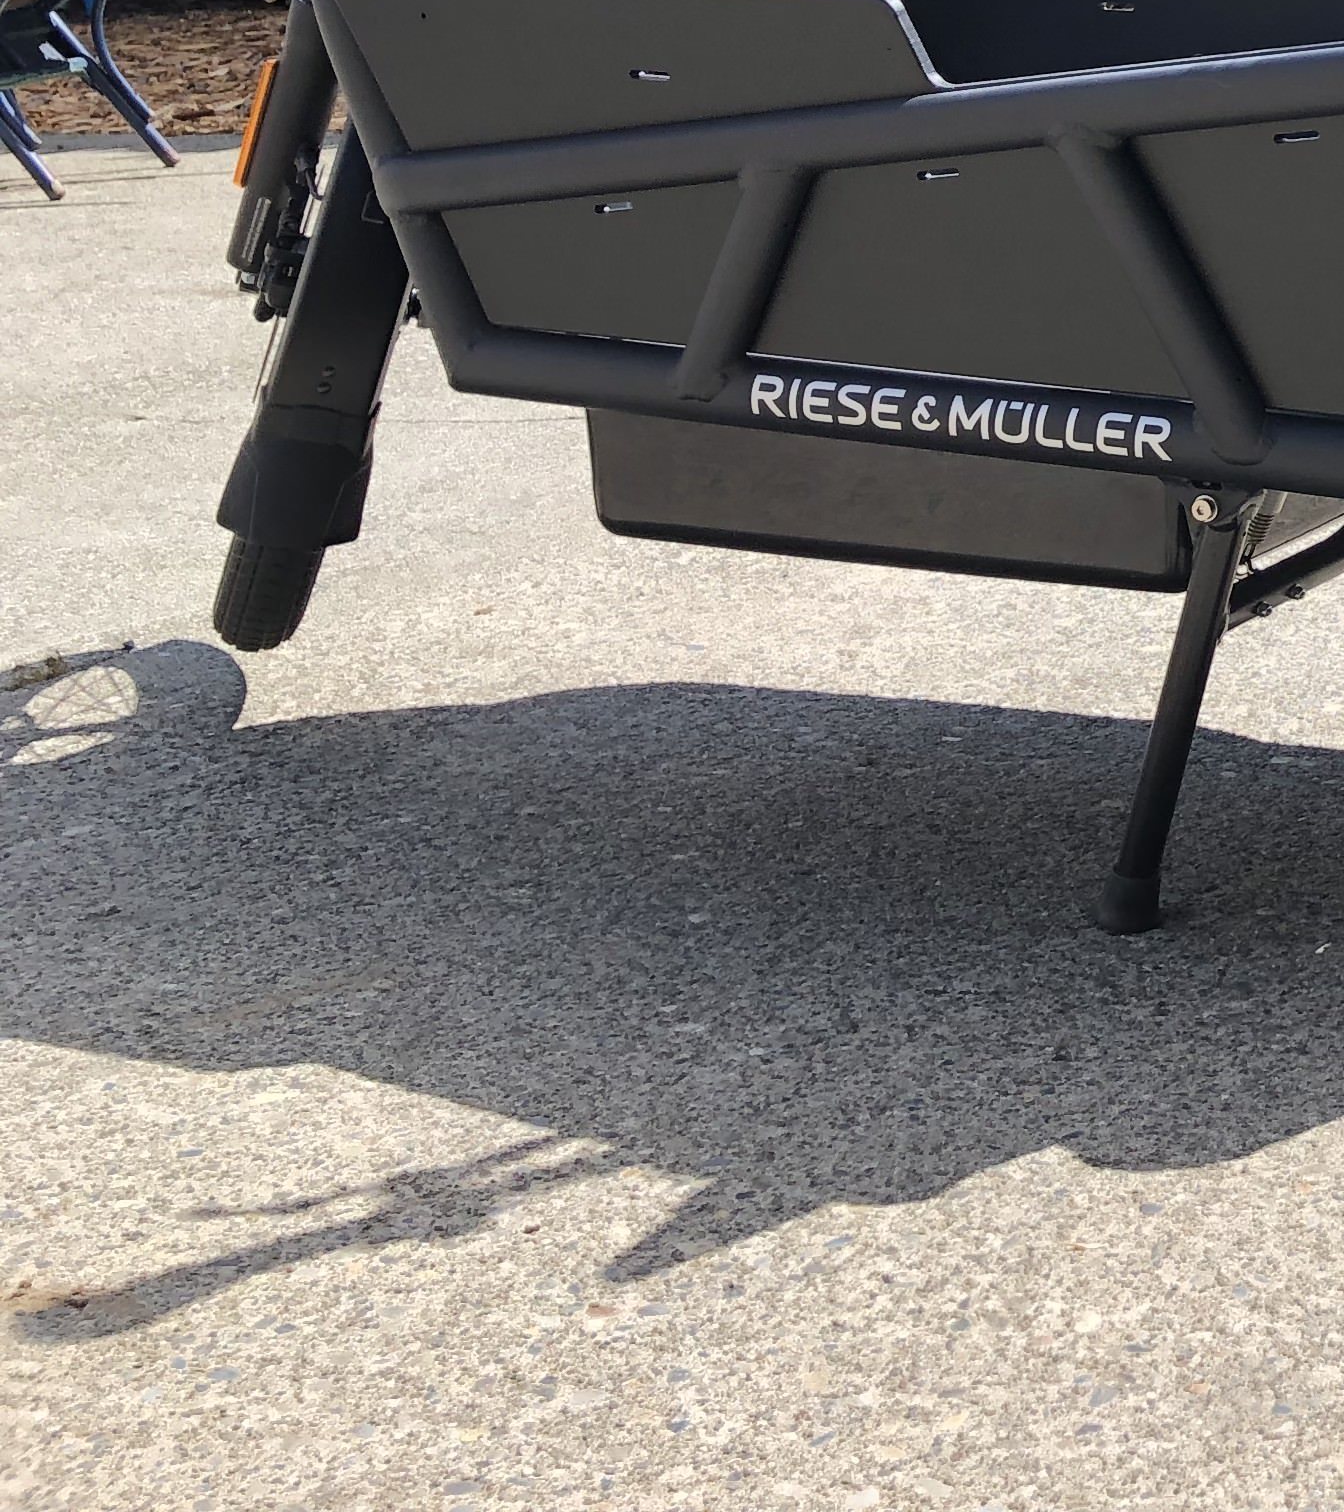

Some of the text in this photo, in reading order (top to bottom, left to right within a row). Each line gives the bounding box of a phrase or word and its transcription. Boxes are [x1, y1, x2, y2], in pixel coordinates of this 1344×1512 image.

[750, 374, 1173, 462] RIESE & MÜLLER
